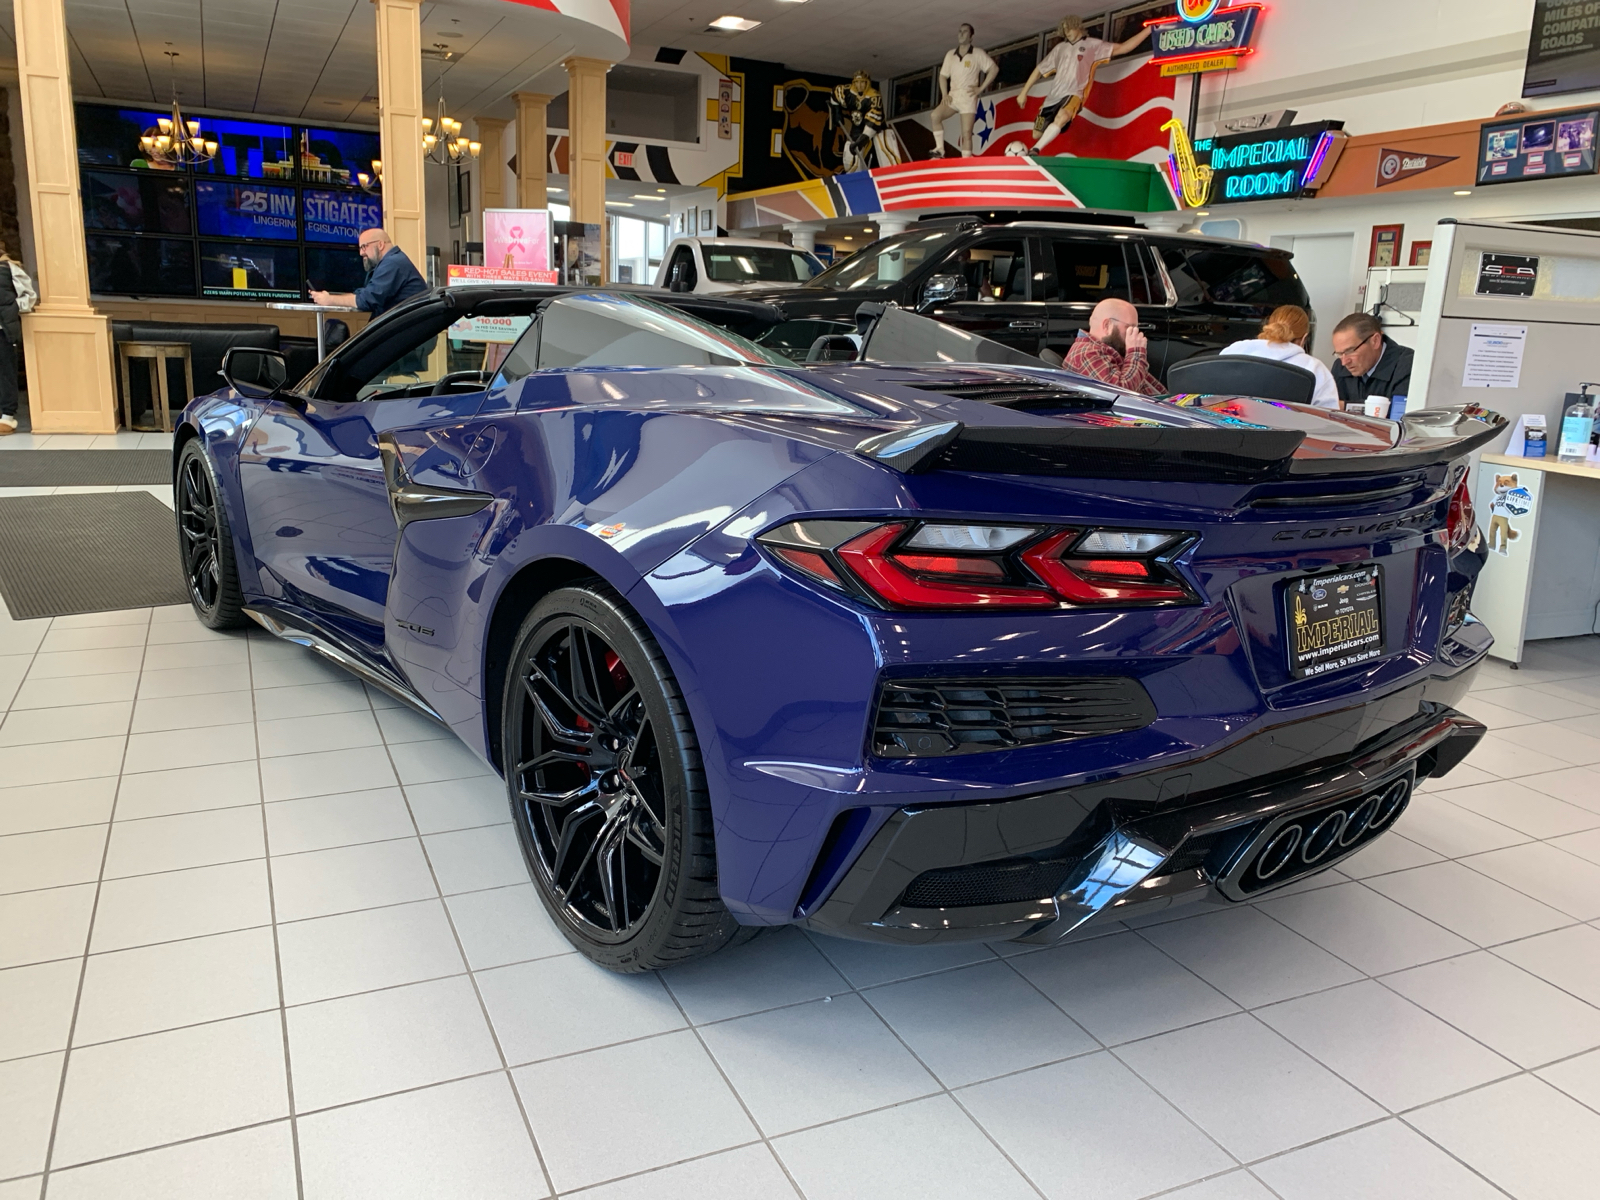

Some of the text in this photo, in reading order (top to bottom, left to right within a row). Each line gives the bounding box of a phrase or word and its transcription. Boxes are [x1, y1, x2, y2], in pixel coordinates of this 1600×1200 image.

[1544, 5, 1582, 22] MILES
[1542, 15, 1600, 36] COMPATI
[1159, 20, 1235, 51] USED CARS
[1540, 32, 1584, 50] ROADS
[1166, 59, 1224, 74] AUTHORIZED DEALER
[1194, 139, 1211, 152] THE
[1211, 137, 1309, 170] IMPERIAL
[618, 151, 633, 166] EXIT
[1226, 169, 1295, 198] ROOM
[240, 190, 268, 213] 25
[464, 267, 554, 279] RED-HOT SALES EVENT
[1482, 265, 1536, 277] SCA
[476, 317, 512, 326] $10,000
[1272, 510, 1437, 541] CORVETTE
[1313, 571, 1366, 587] Imperialcars.com
[1339, 606, 1354, 614] TOYOTA
[1297, 608, 1379, 653] IMPERIAL
[1298, 634, 1379, 662] www.imperialcars.com
[1304, 649, 1380, 676] We Sell More, So You Save More
[664, 811, 682, 906] MICHELIN
